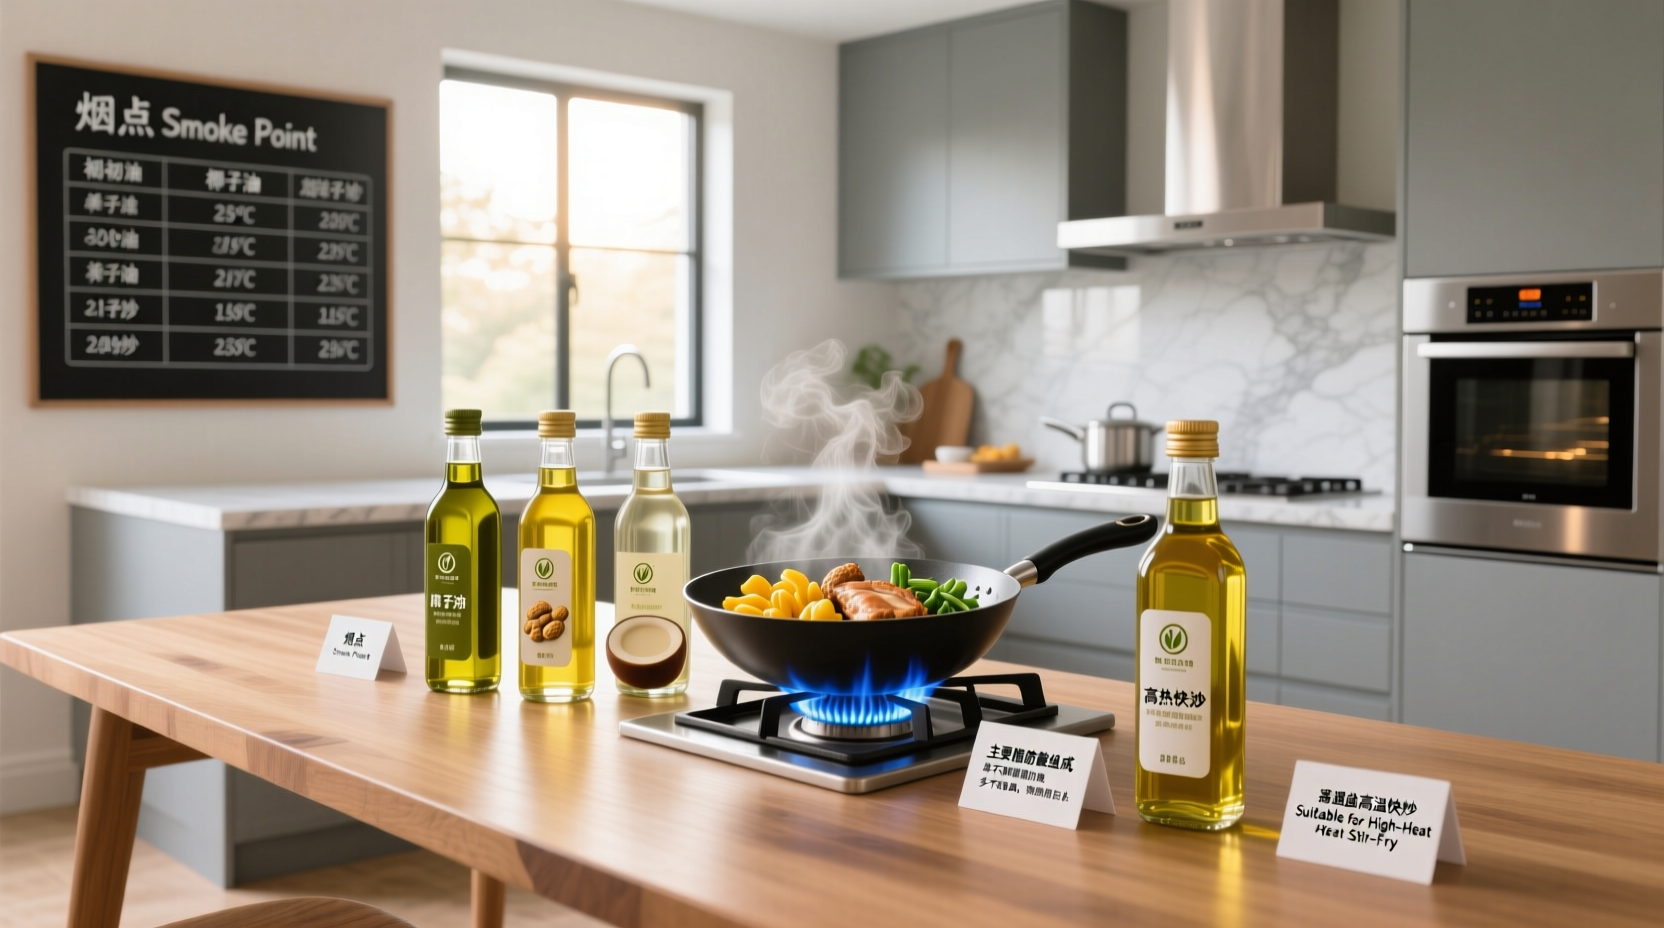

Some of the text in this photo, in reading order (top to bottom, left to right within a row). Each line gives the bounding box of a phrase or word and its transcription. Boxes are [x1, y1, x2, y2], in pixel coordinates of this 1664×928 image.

[75, 91, 318, 152] 烟点 Smoke Point
[1295, 803, 1344, 824] Suitable
[1368, 816, 1433, 838] High-Heat
